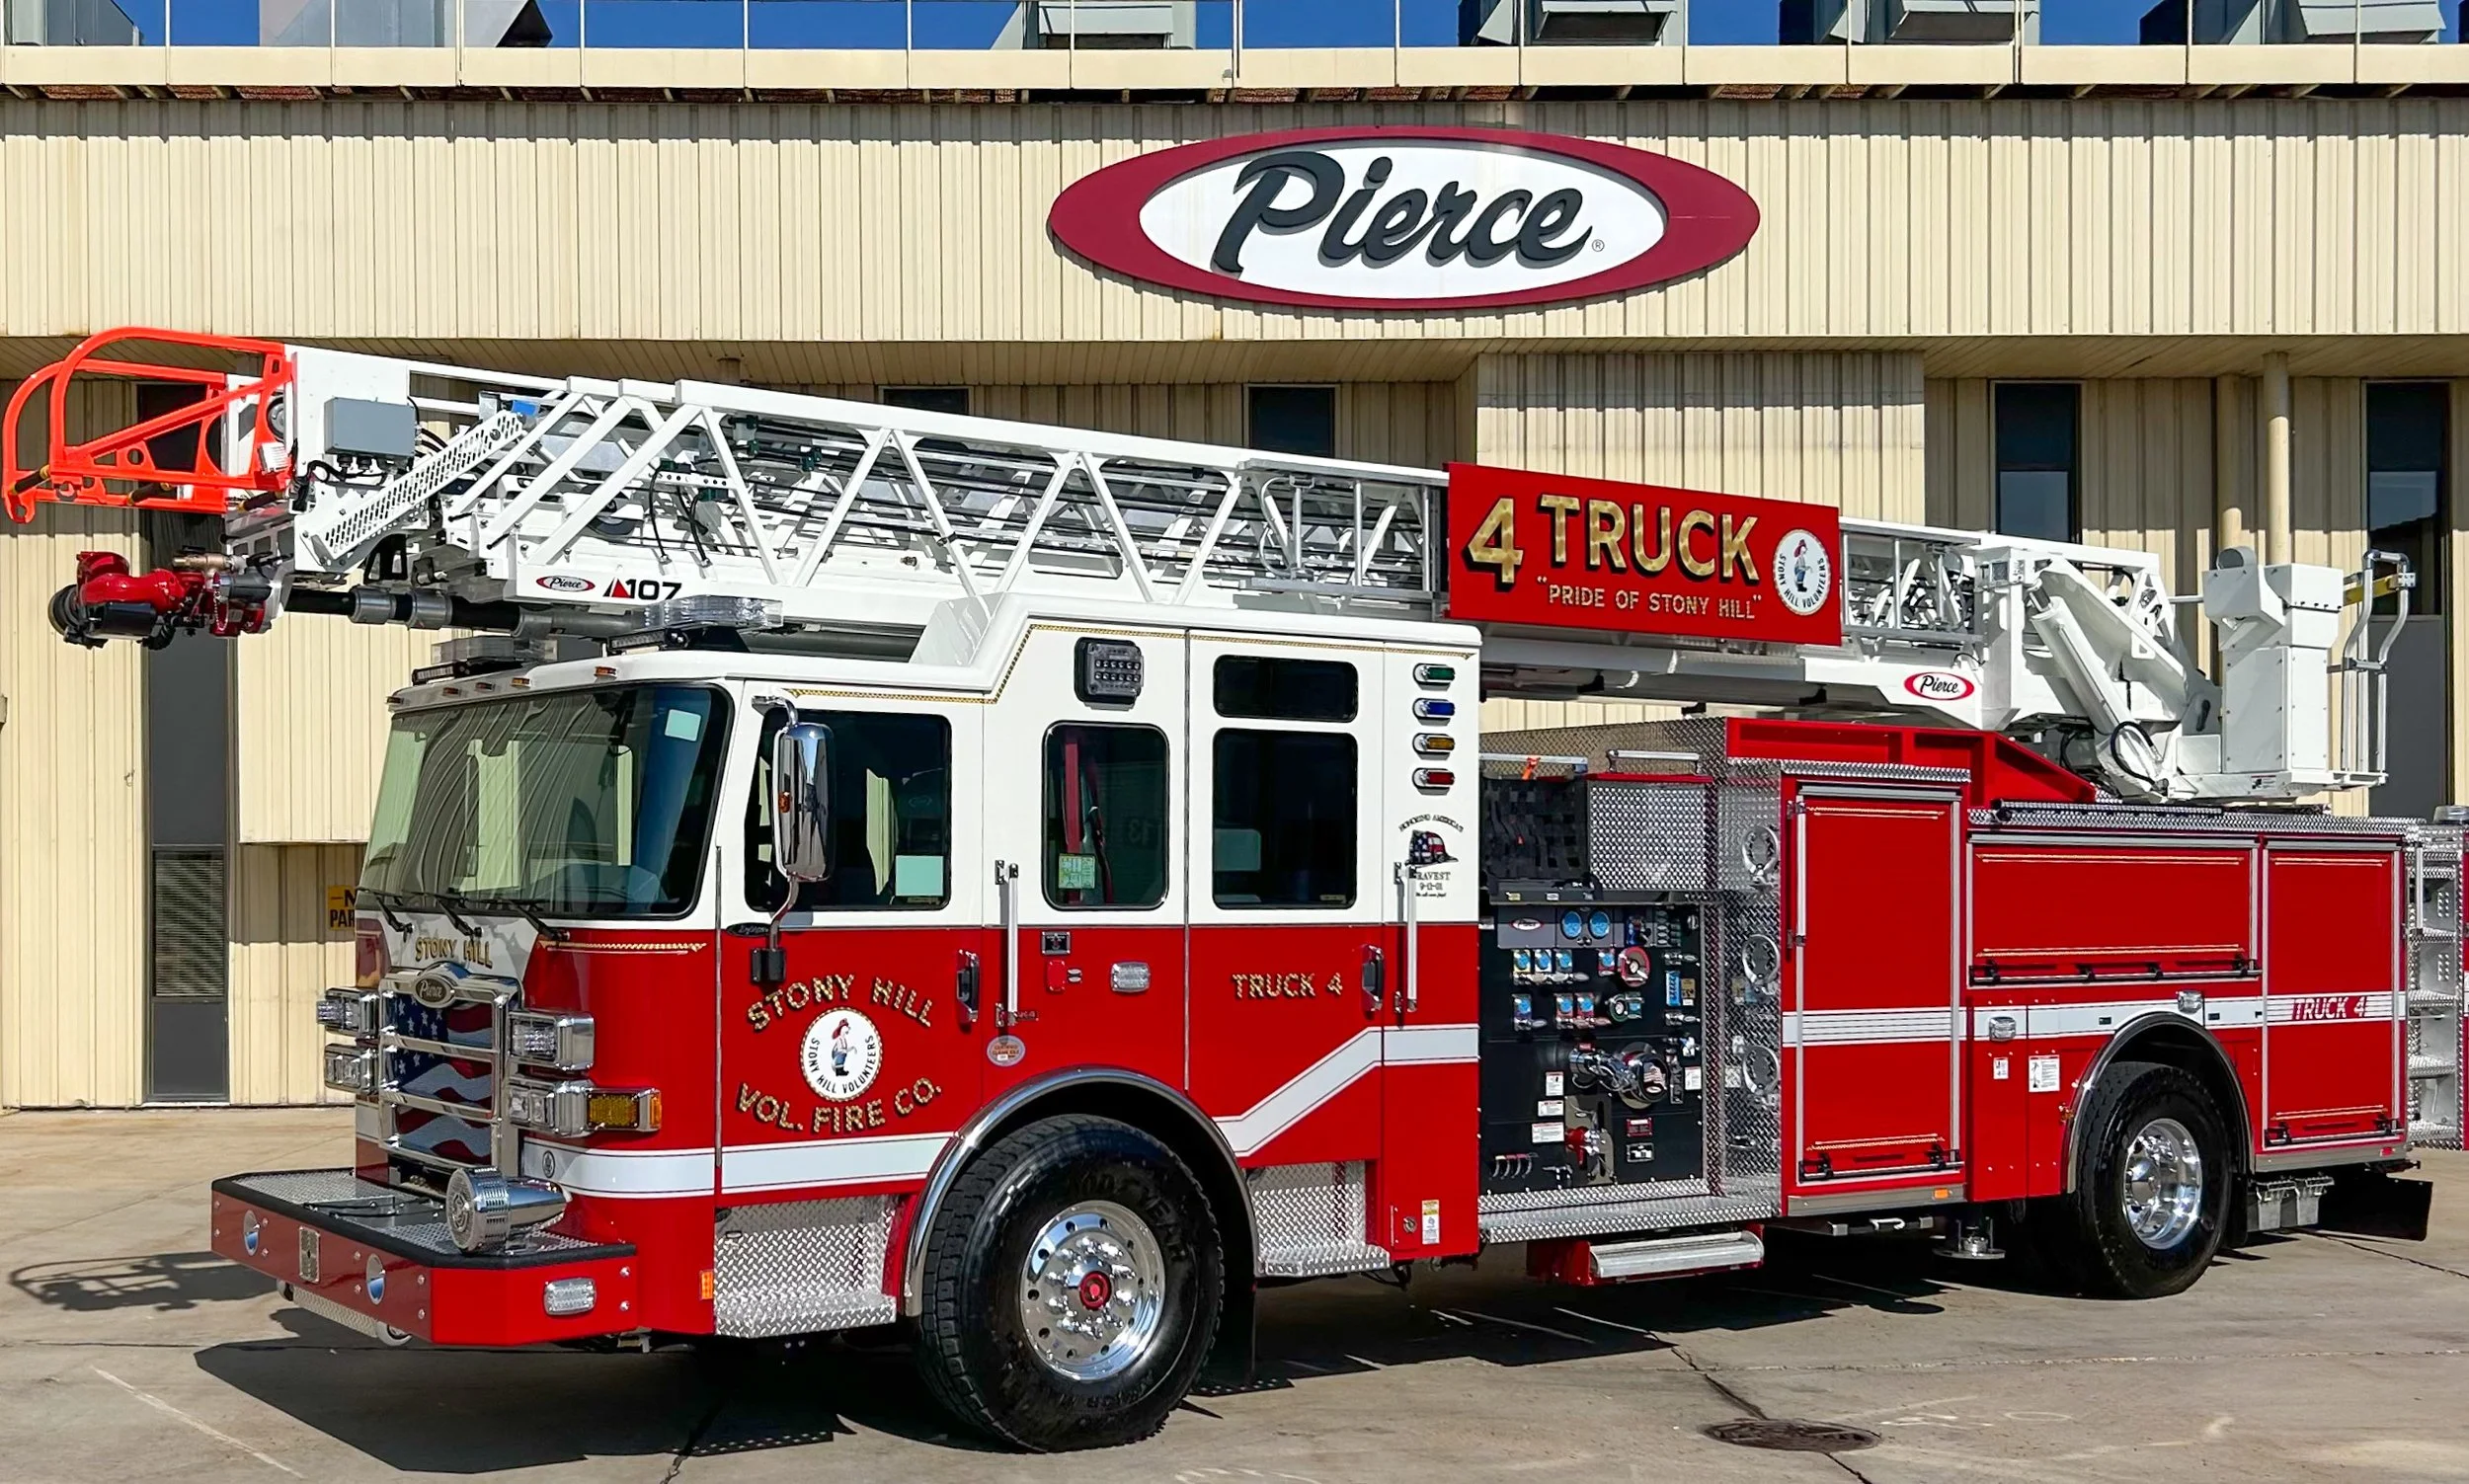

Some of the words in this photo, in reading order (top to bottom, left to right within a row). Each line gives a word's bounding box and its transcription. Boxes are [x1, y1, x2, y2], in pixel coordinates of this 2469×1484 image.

[1210, 151, 1592, 273] Pierce
[1465, 497, 1524, 588] 4
[1539, 493, 1760, 582] TRUCK
[549, 577, 583, 589] Pierce
[625, 579, 682, 600] 107
[1778, 553, 1787, 586] STONY
[1784, 588, 1799, 607] HILL
[1615, 588, 1639, 610] OF
[1648, 592, 1711, 616] STONY
[1919, 674, 1959, 694] Pierce
[1414, 872, 1451, 881] RAVEST
[415, 937, 457, 962] STONY
[463, 940, 493, 970] HILL
[1232, 973, 1316, 999] TRUCK
[1326, 972, 1344, 996] 4
[748, 974, 855, 1031] STONY
[871, 976, 932, 1028] HILL
[2294, 996, 2350, 1020] TRUCK
[2353, 996, 2365, 1017] 4
[808, 1037, 821, 1073] STONY
[816, 1074, 837, 1094] HILL
[841, 1034, 877, 1094] VOLUNTEERS
[738, 1082, 804, 1132] VOL.
[813, 1098, 886, 1133] FIRE
[894, 1076, 942, 1116] CO.
